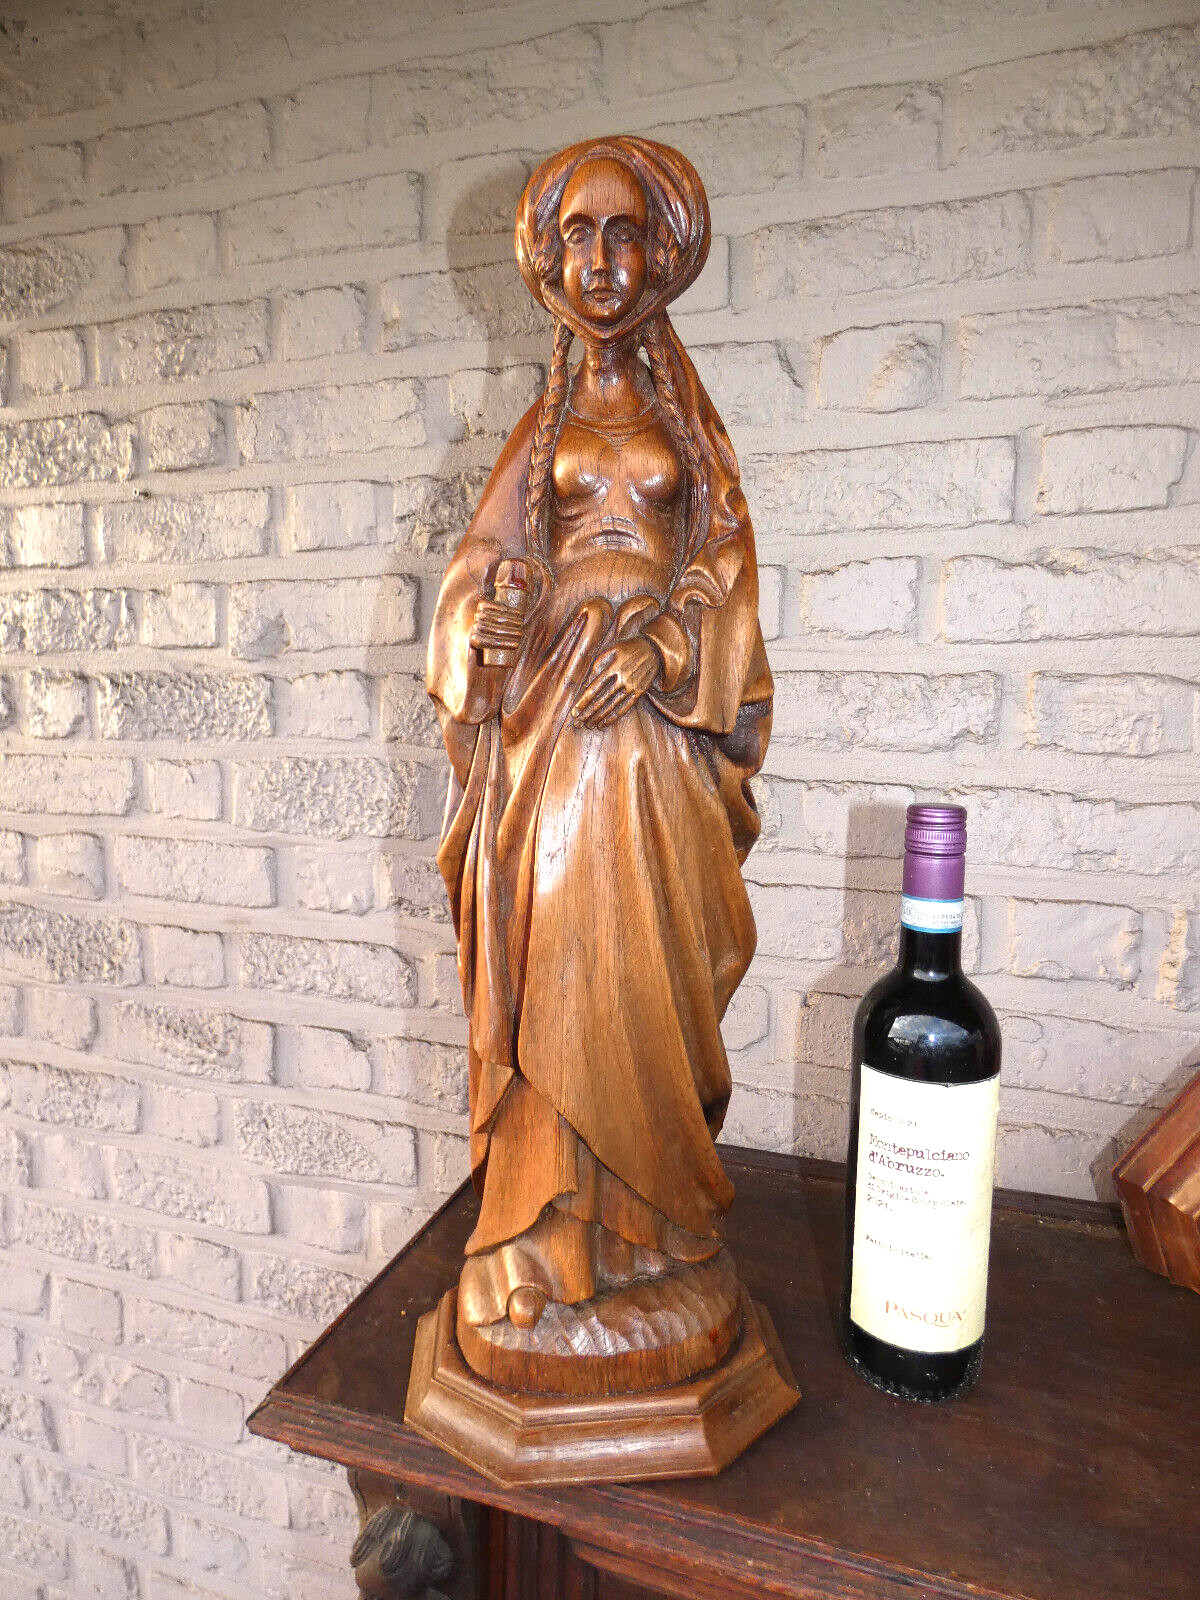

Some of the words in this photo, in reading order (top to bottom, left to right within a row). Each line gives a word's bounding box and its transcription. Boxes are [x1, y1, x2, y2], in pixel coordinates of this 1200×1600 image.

[869, 1132, 970, 1161] Montepulciano
[868, 1150, 945, 1178] d'Abruzzo.
[885, 1300, 963, 1327] PASQUA
